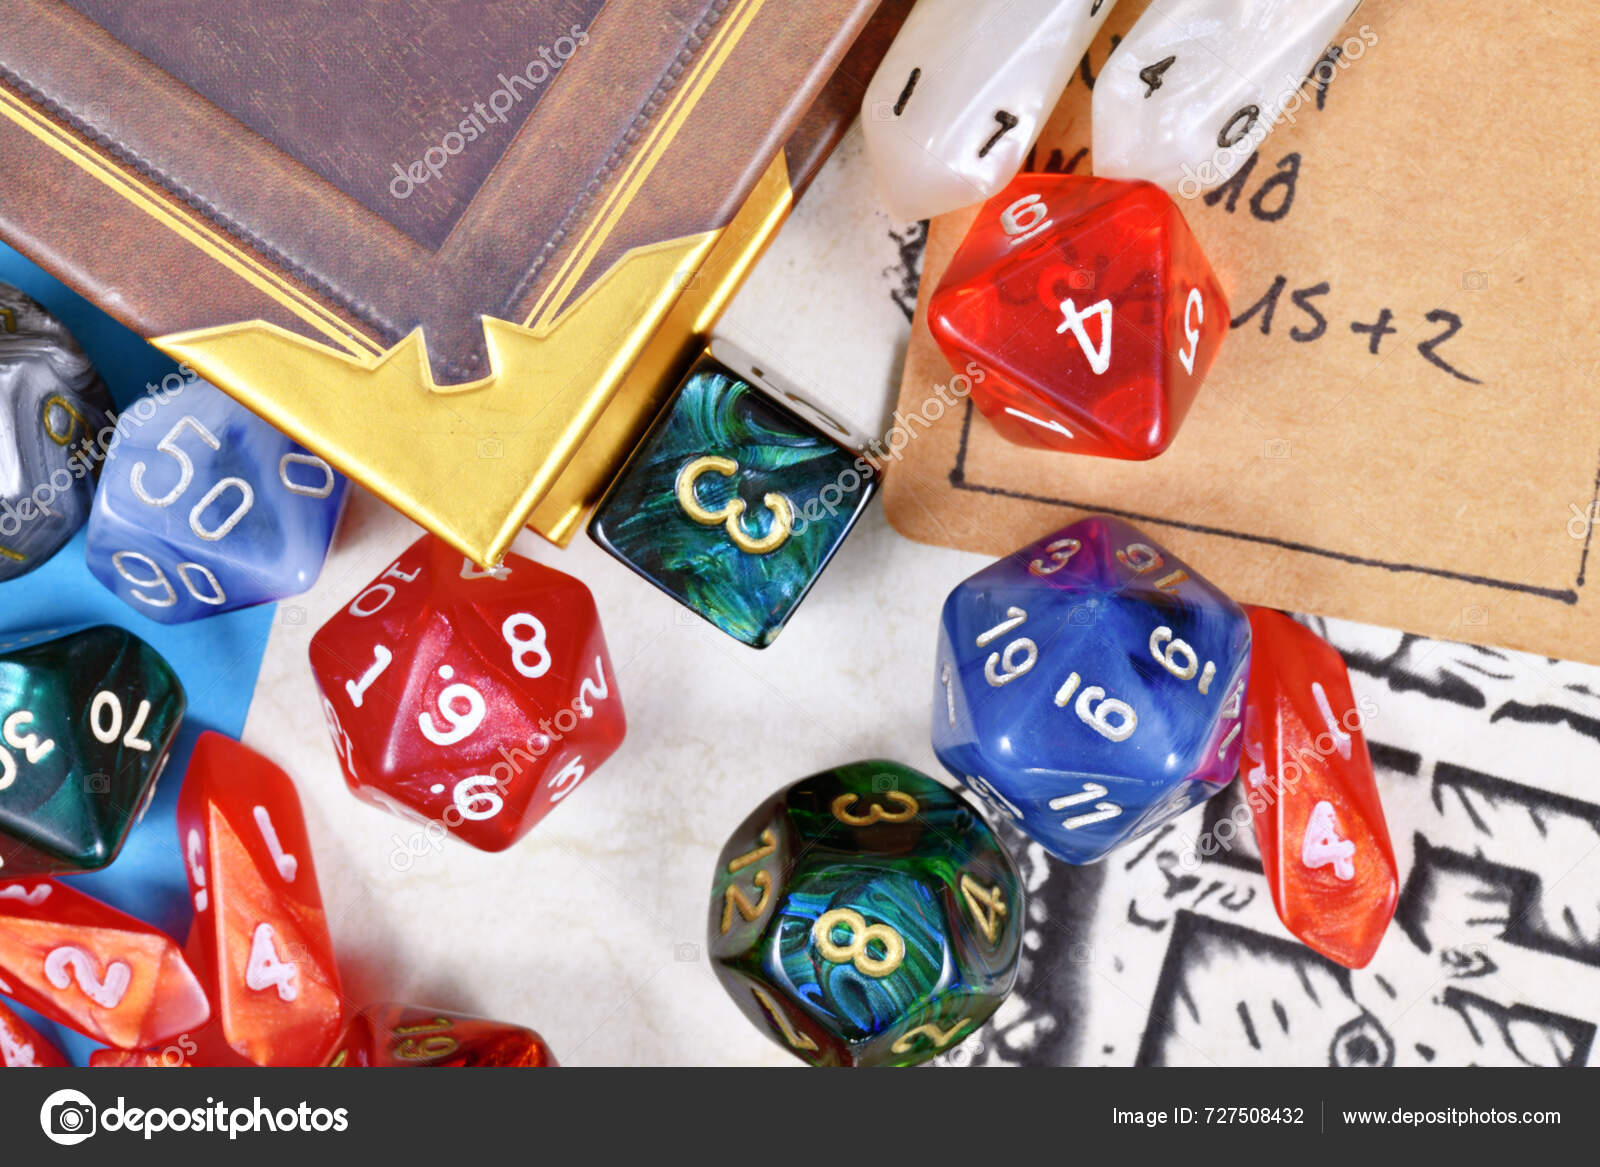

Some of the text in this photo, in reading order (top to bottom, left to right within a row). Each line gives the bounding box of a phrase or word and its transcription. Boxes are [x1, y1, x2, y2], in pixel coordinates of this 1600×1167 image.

[894, 67, 921, 117] 1
[1139, 56, 1176, 99] 4
[978, 110, 1018, 158] 7
[1056, 298, 1113, 375] 4
[1179, 288, 1204, 376] 5
[1004, 406, 1074, 439] 1
[130, 416, 254, 541] 50
[676, 455, 795, 554] 3
[112, 551, 227, 607] 90
[349, 561, 422, 617] 10
[1022, 538, 1082, 576] 3
[345, 644, 392, 708] 1
[502, 612, 552, 678] 8
[579, 655, 609, 719] 2
[90, 690, 152, 752] 70
[547, 755, 585, 803] 3
[832, 791, 919, 826] 3
[253, 805, 298, 883] 1
[1303, 801, 1356, 881] 4
[720, 829, 777, 935] 12
[961, 874, 1007, 944] 4
[246, 922, 299, 1002] 4
[813, 907, 905, 978] 8
[44, 946, 132, 1009] 2
